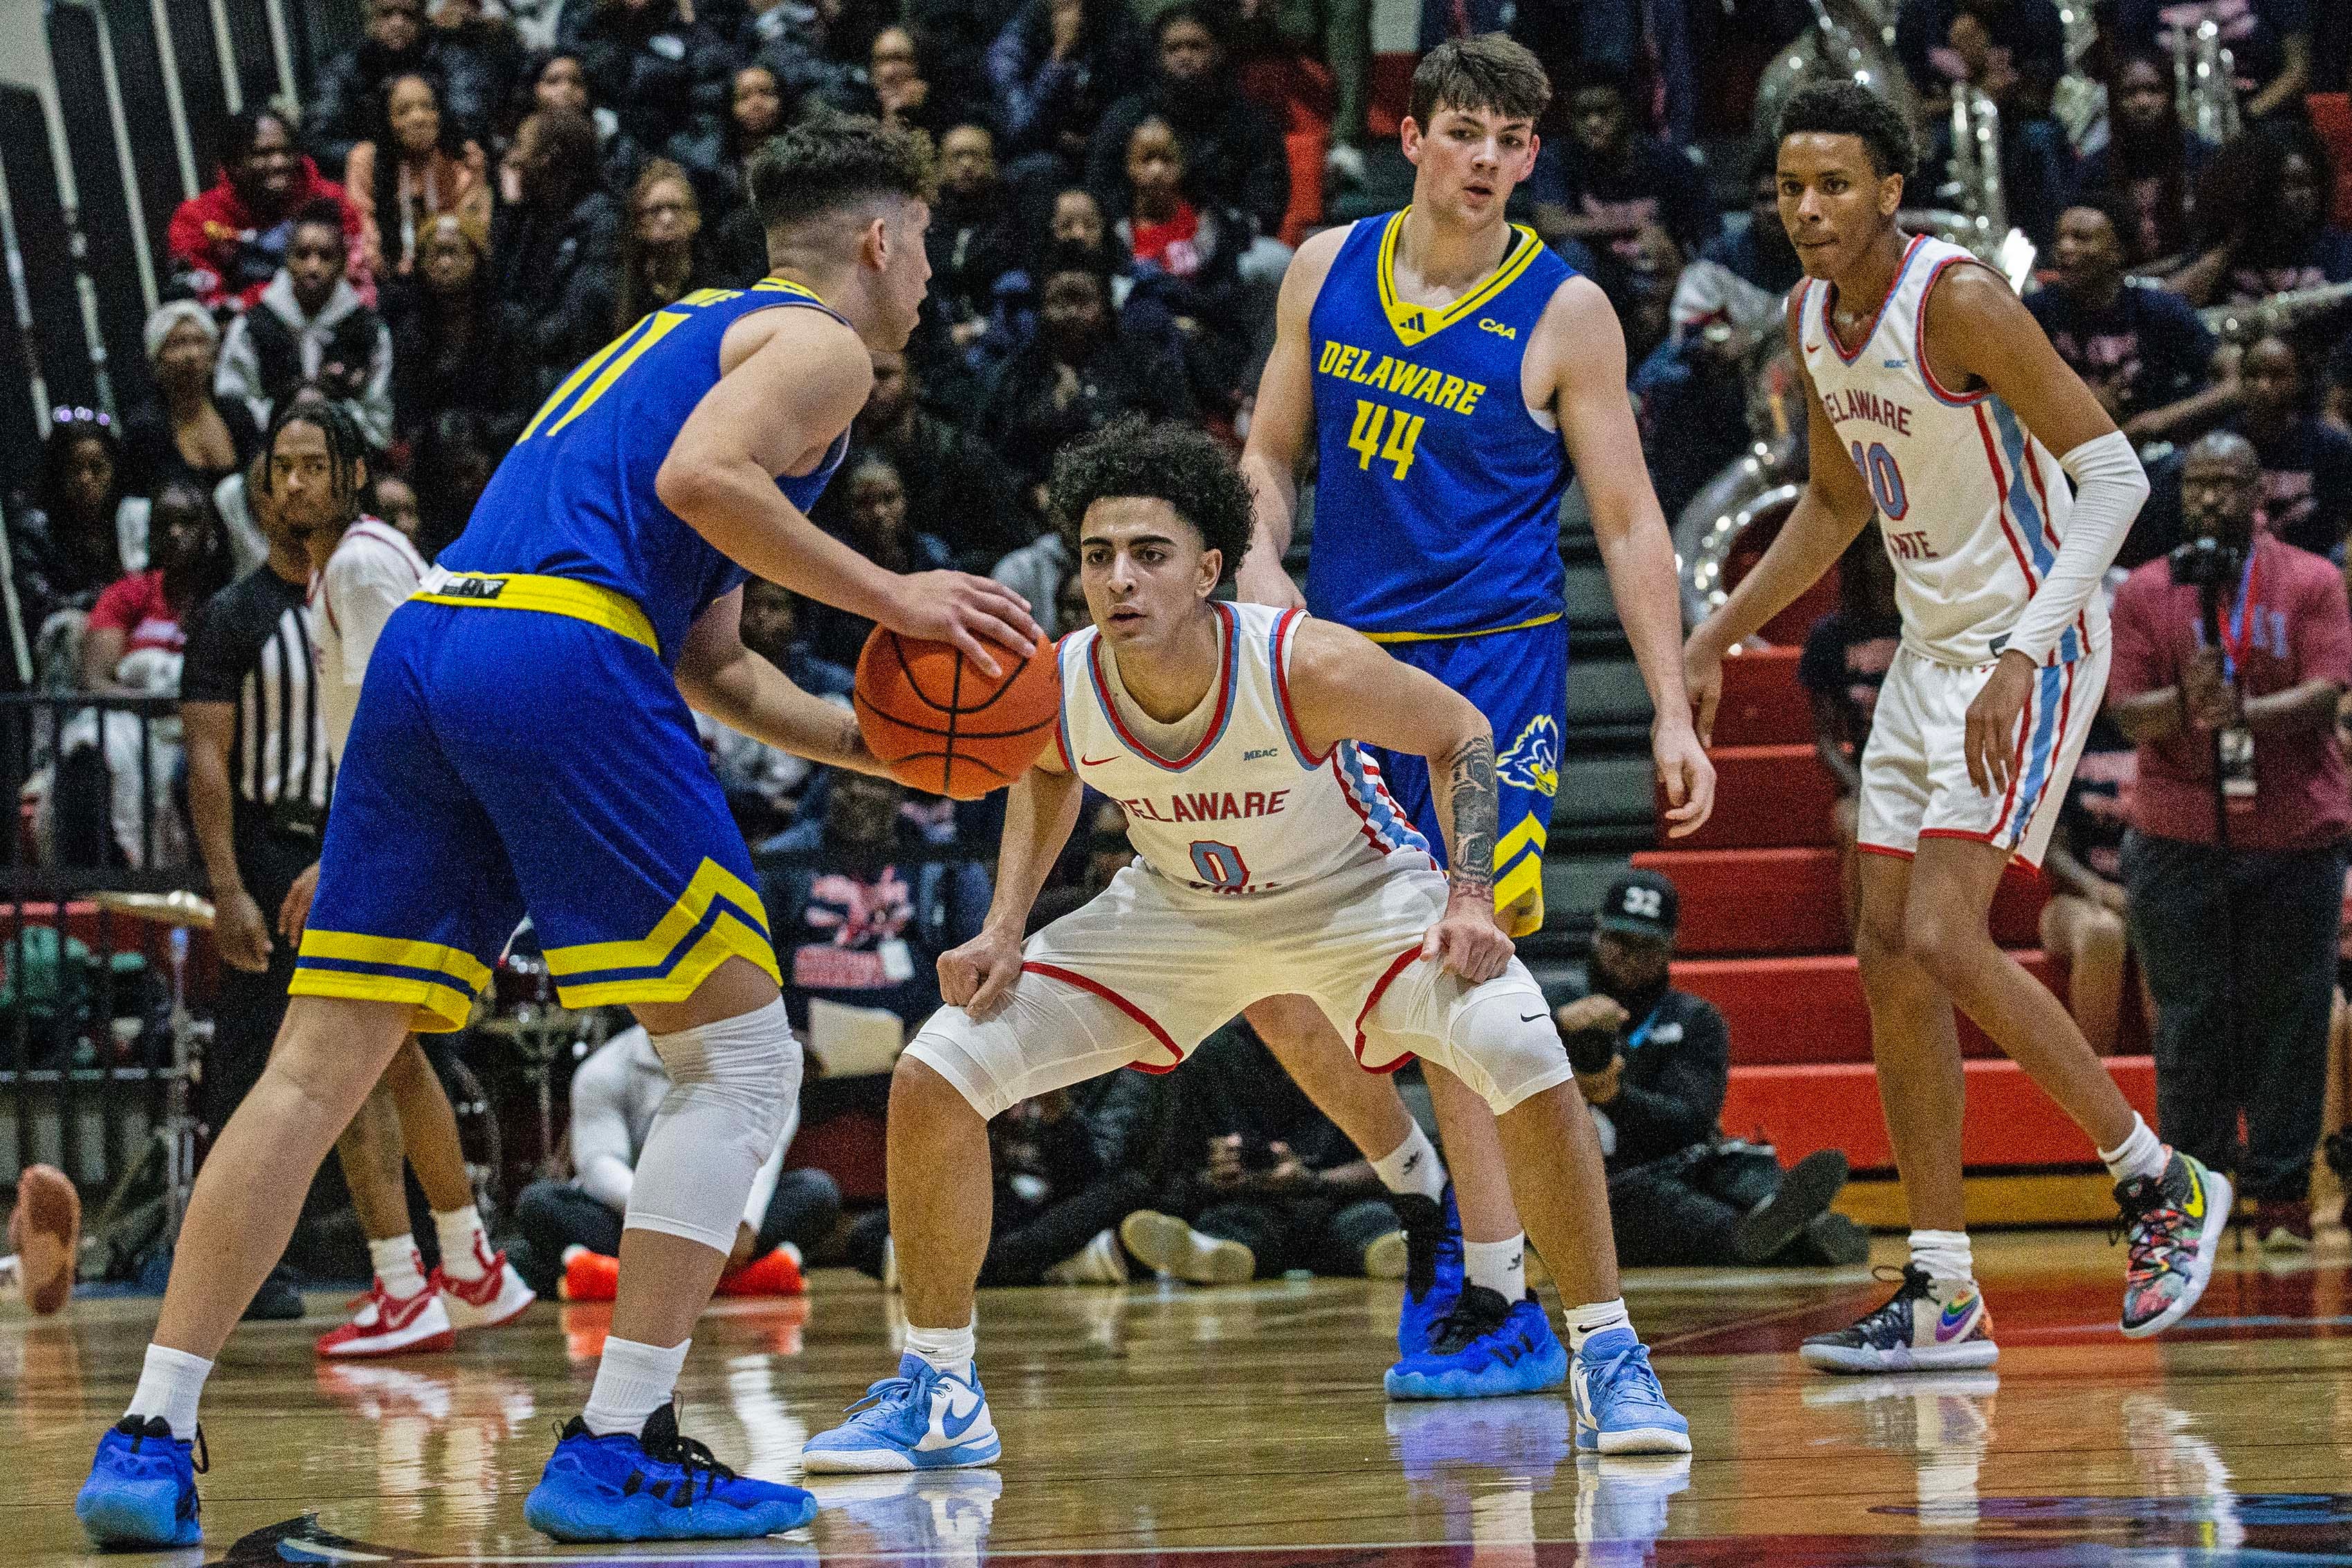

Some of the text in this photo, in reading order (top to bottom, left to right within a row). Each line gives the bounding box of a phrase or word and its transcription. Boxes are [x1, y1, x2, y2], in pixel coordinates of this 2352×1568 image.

[1478, 317, 1516, 340] CAA
[1318, 340, 1487, 415] DELAWARE
[1823, 388, 1913, 436] ELAWARE
[1348, 399, 1426, 481] 44
[1243, 748, 1278, 761] MEAC
[1111, 788, 1291, 823] ELAWARE
[1188, 840, 1251, 887] 0
